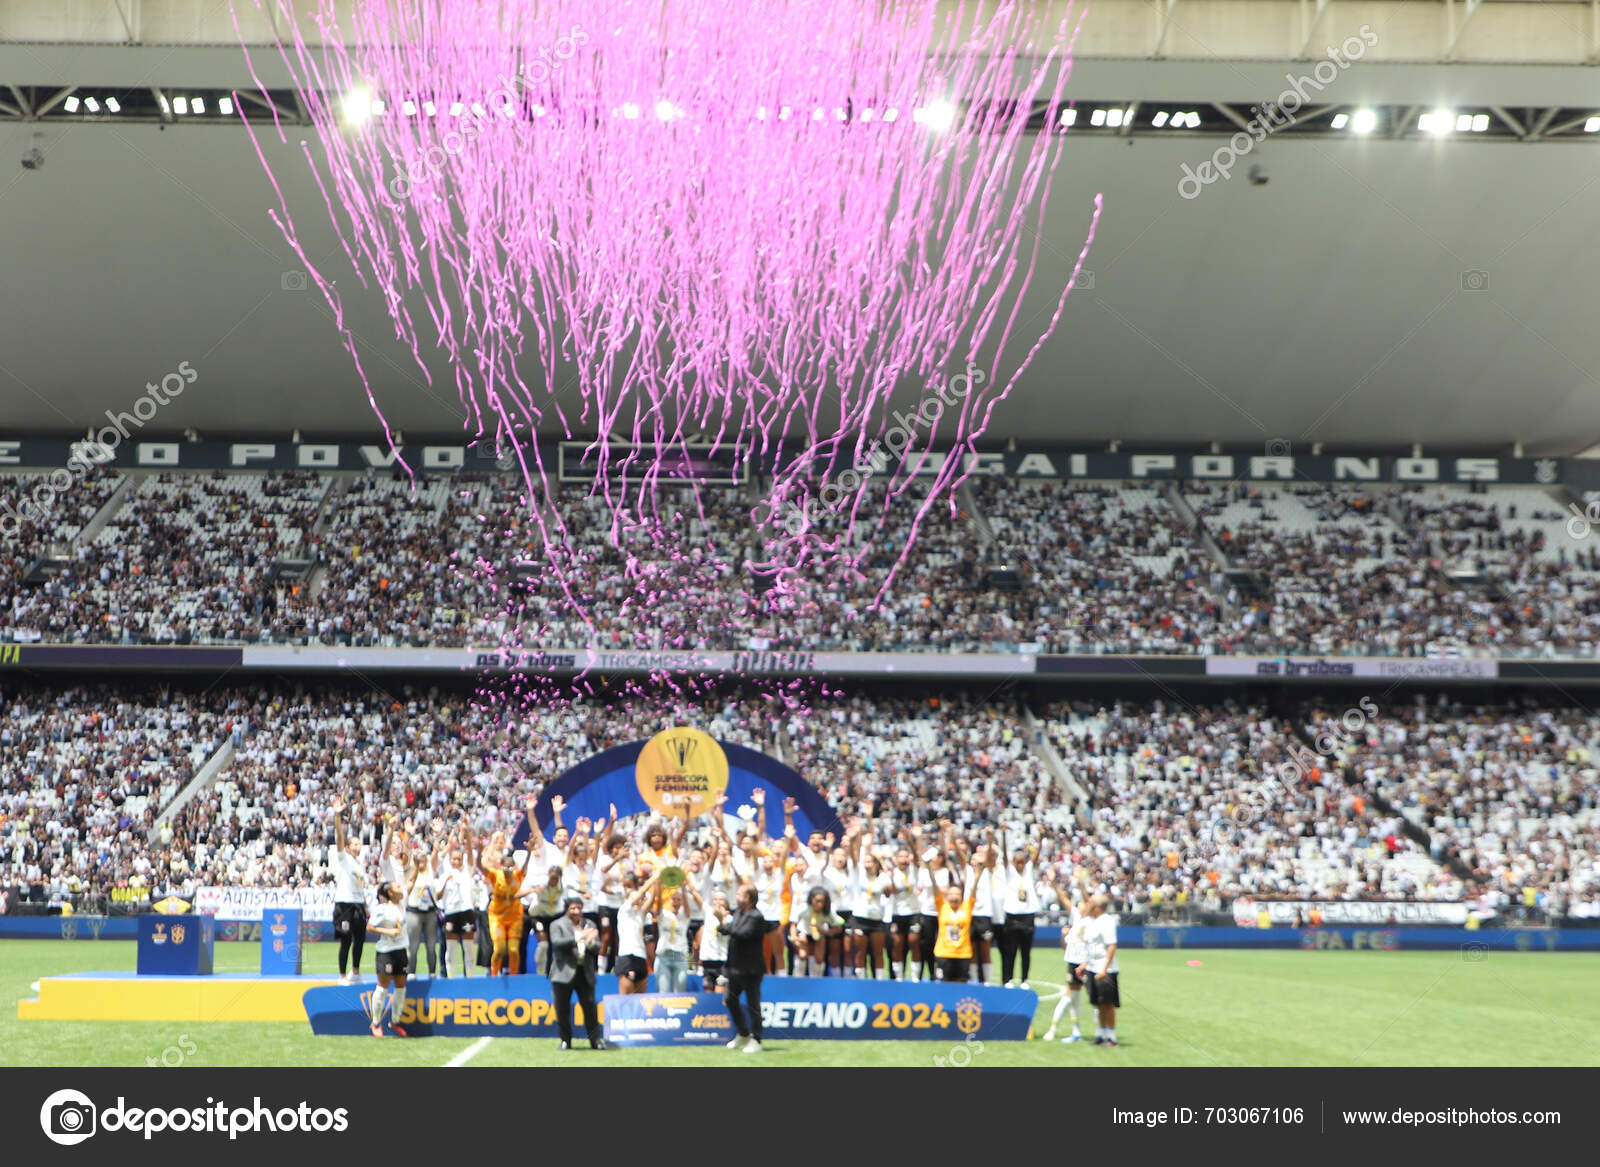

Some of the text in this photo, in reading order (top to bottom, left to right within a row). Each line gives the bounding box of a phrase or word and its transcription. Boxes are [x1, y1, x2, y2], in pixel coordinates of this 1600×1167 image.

[231, 443, 464, 467] POVO
[1131, 454, 1295, 478] POR
[655, 774, 708, 783] SUPERCOPA
[655, 784, 708, 792] FEMININA
[760, 1002, 867, 1028] BETANO
[872, 1003, 951, 1028] 2024
